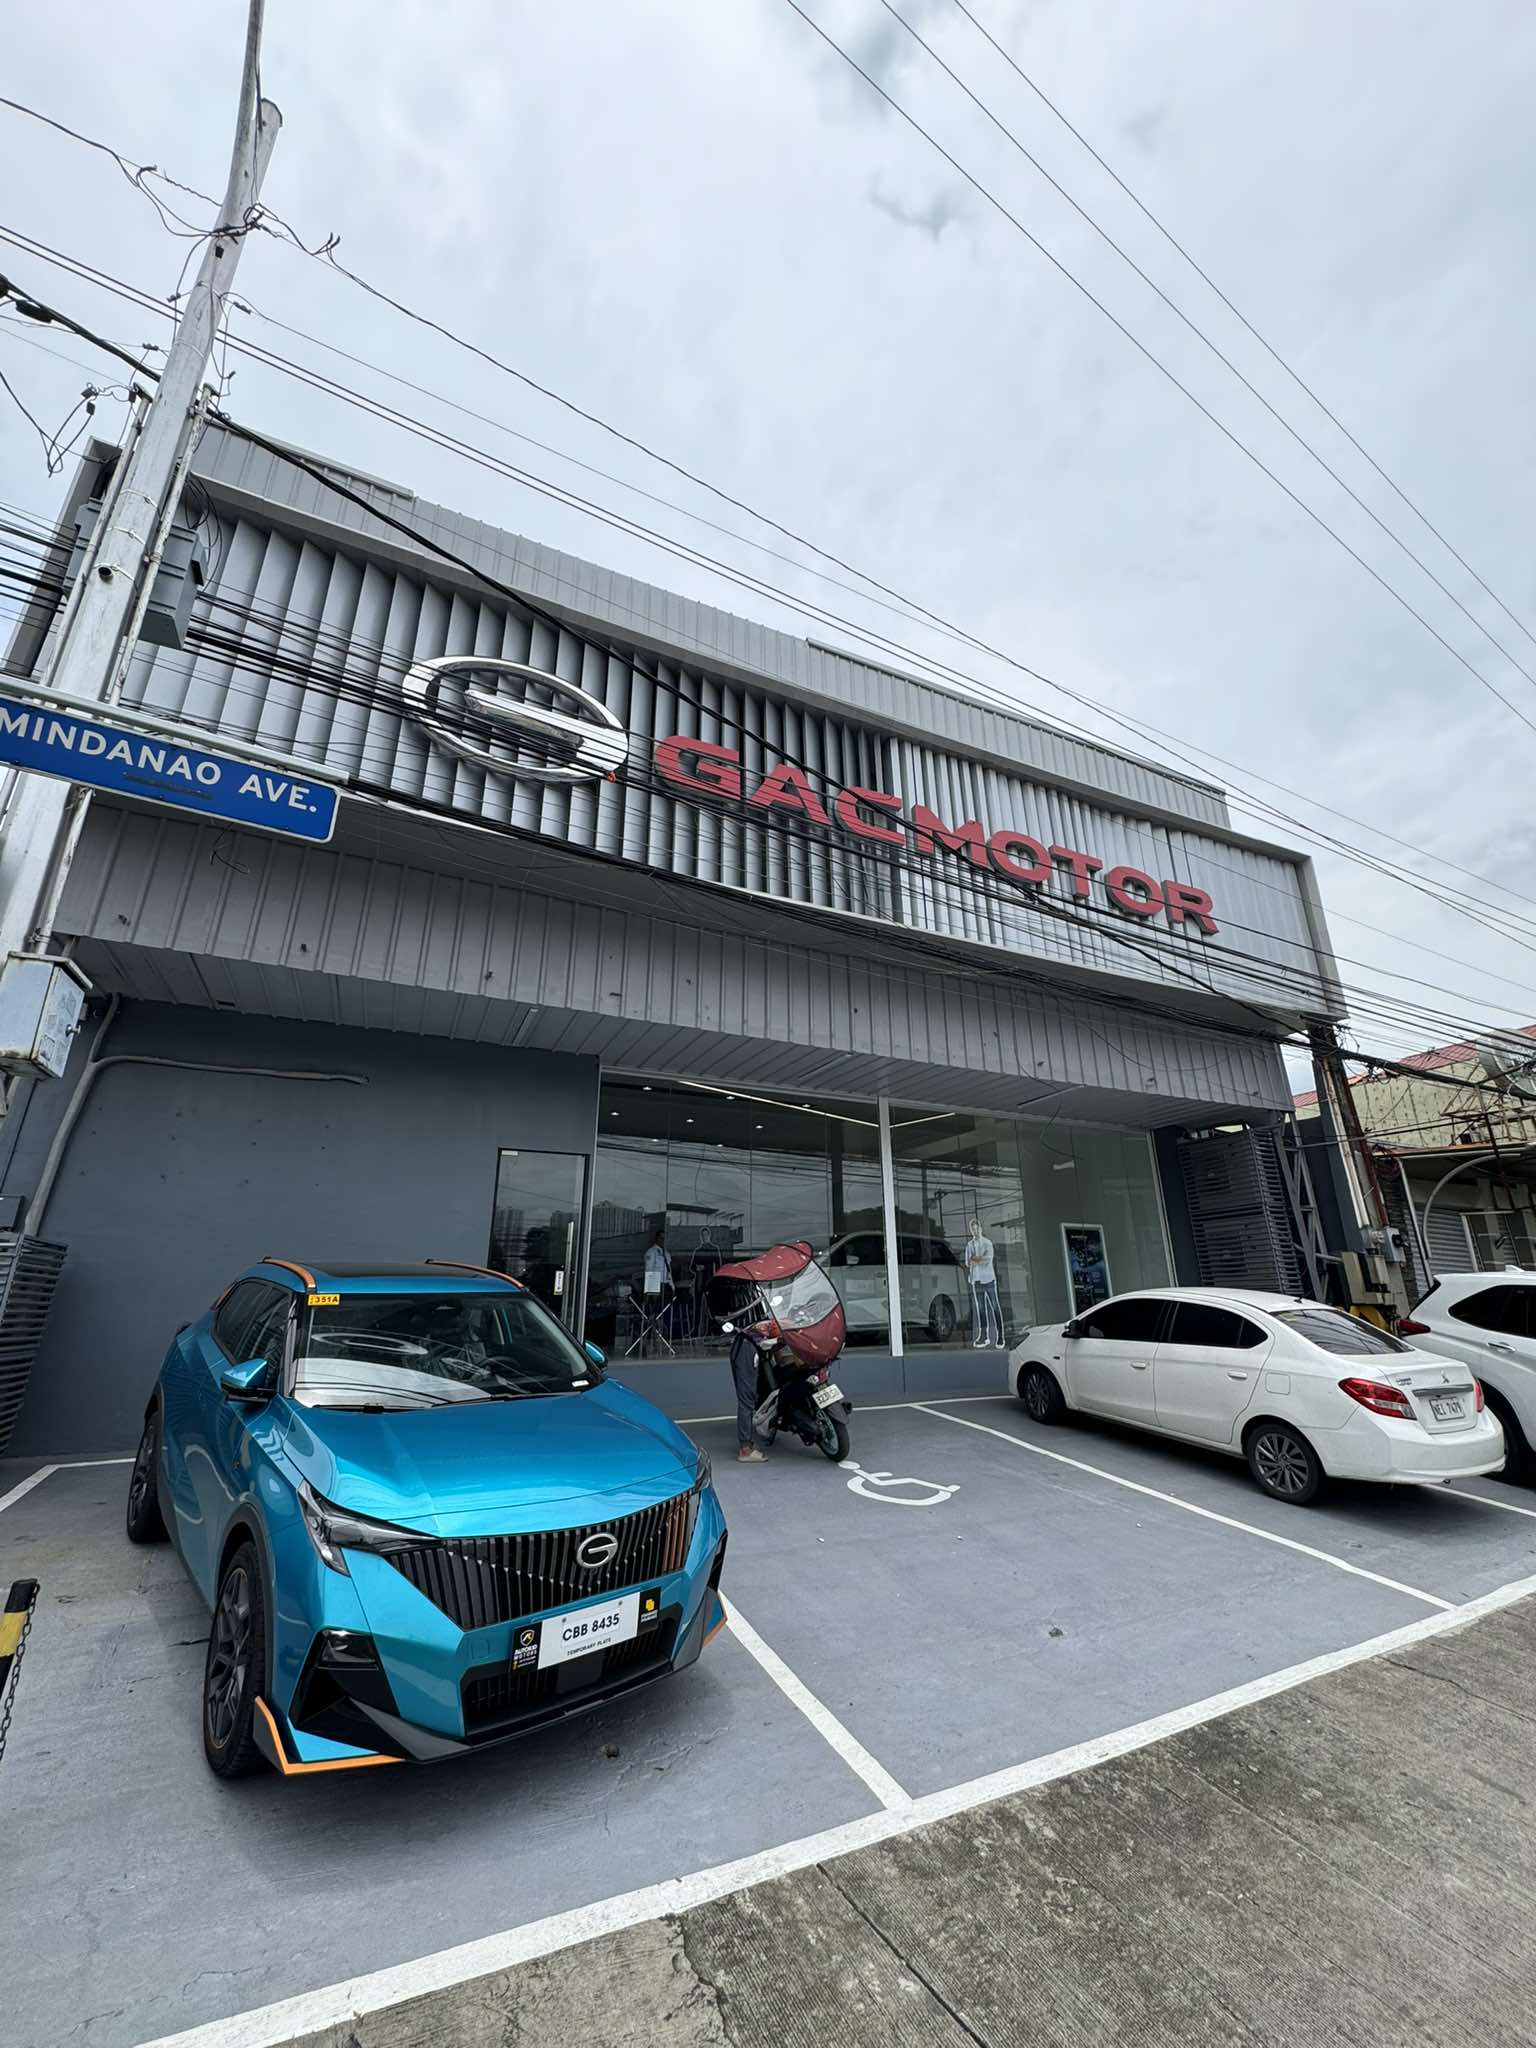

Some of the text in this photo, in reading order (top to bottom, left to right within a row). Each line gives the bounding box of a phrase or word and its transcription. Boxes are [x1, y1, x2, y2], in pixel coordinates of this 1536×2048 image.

[0, 707, 318, 813] MINDANAO AVE.
[562, 1623, 588, 1641] CBB
[592, 1613, 619, 1632] 8435
[567, 1637, 611, 1656] TEMPORARY PLATE
